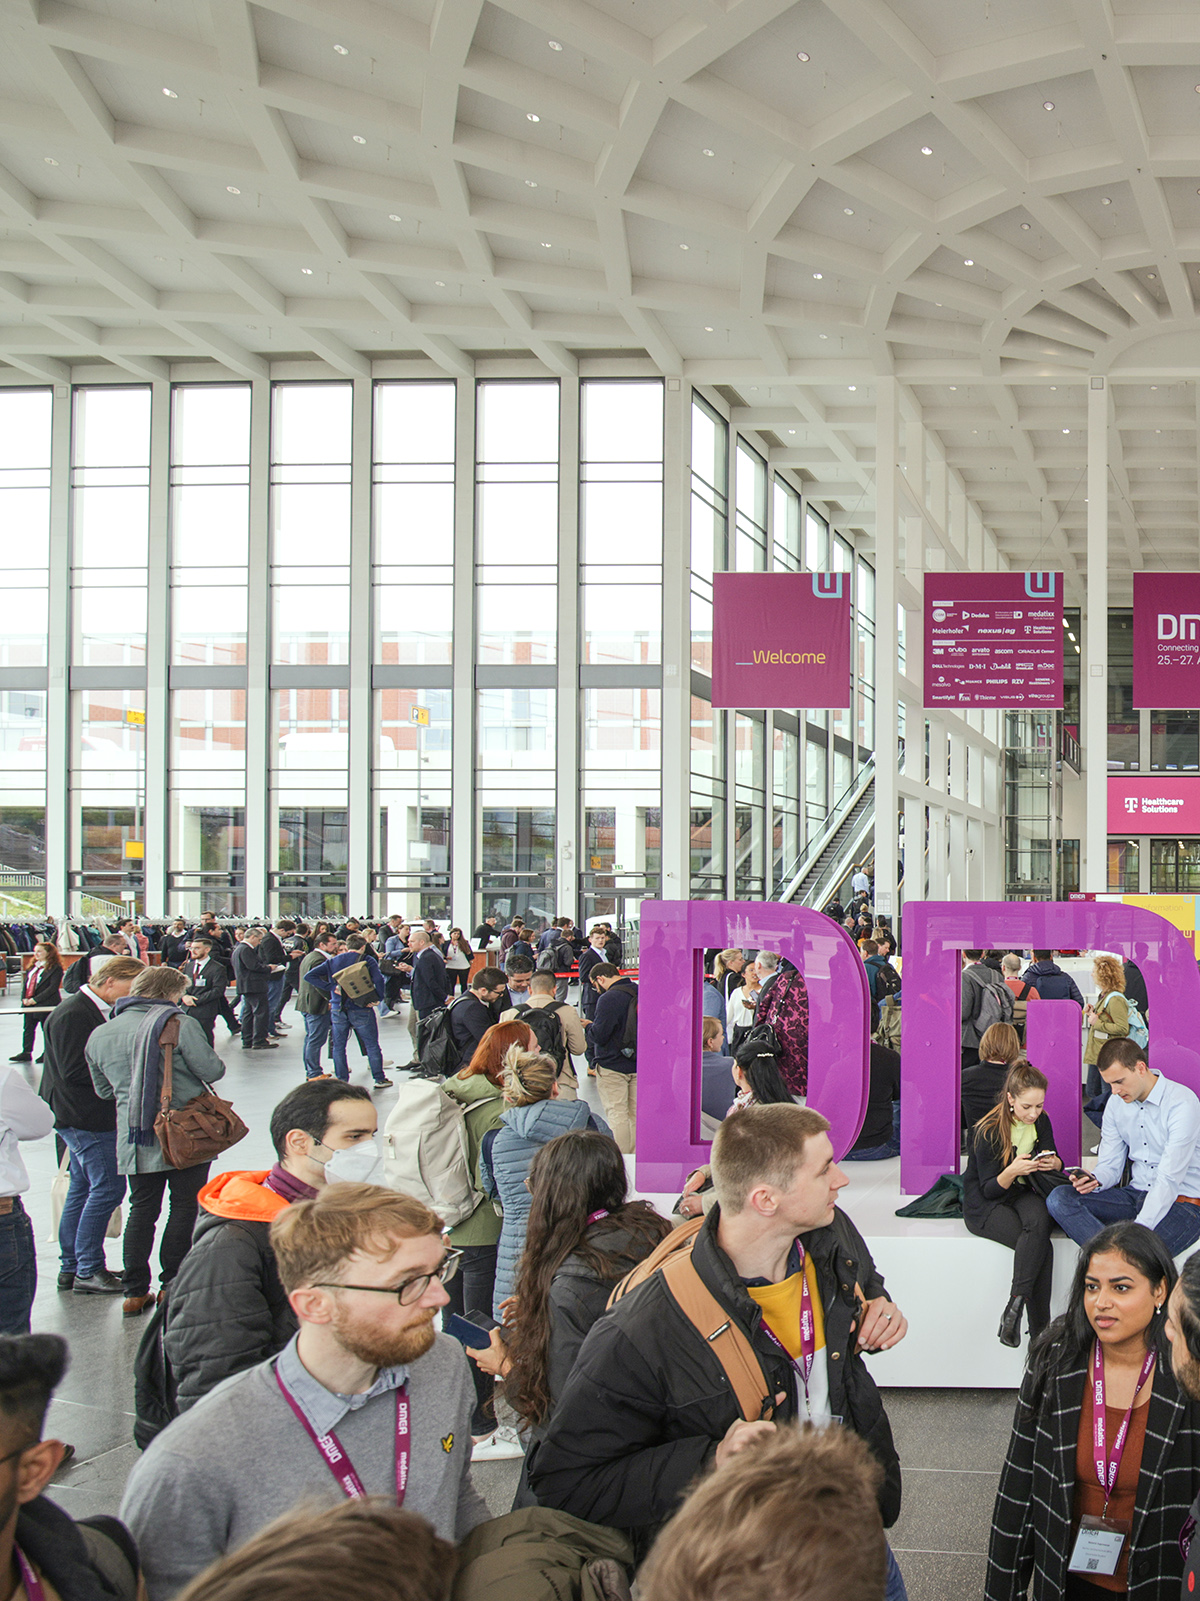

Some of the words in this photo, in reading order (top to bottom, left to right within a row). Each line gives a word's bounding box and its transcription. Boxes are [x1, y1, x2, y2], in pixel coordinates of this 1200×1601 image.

[1157, 644, 1199, 653] Connecting
[1141, 797, 1185, 805] Healthcare
[1141, 805, 1178, 813] Solutions
[801, 1310, 809, 1342] medatixx
[1095, 1380, 1103, 1405] DMEA
[398, 1402, 408, 1435] DMEA
[1115, 1420, 1127, 1449] medatixx
[400, 1452, 408, 1490] medatixx
[1108, 1461, 1117, 1487] DMEA
